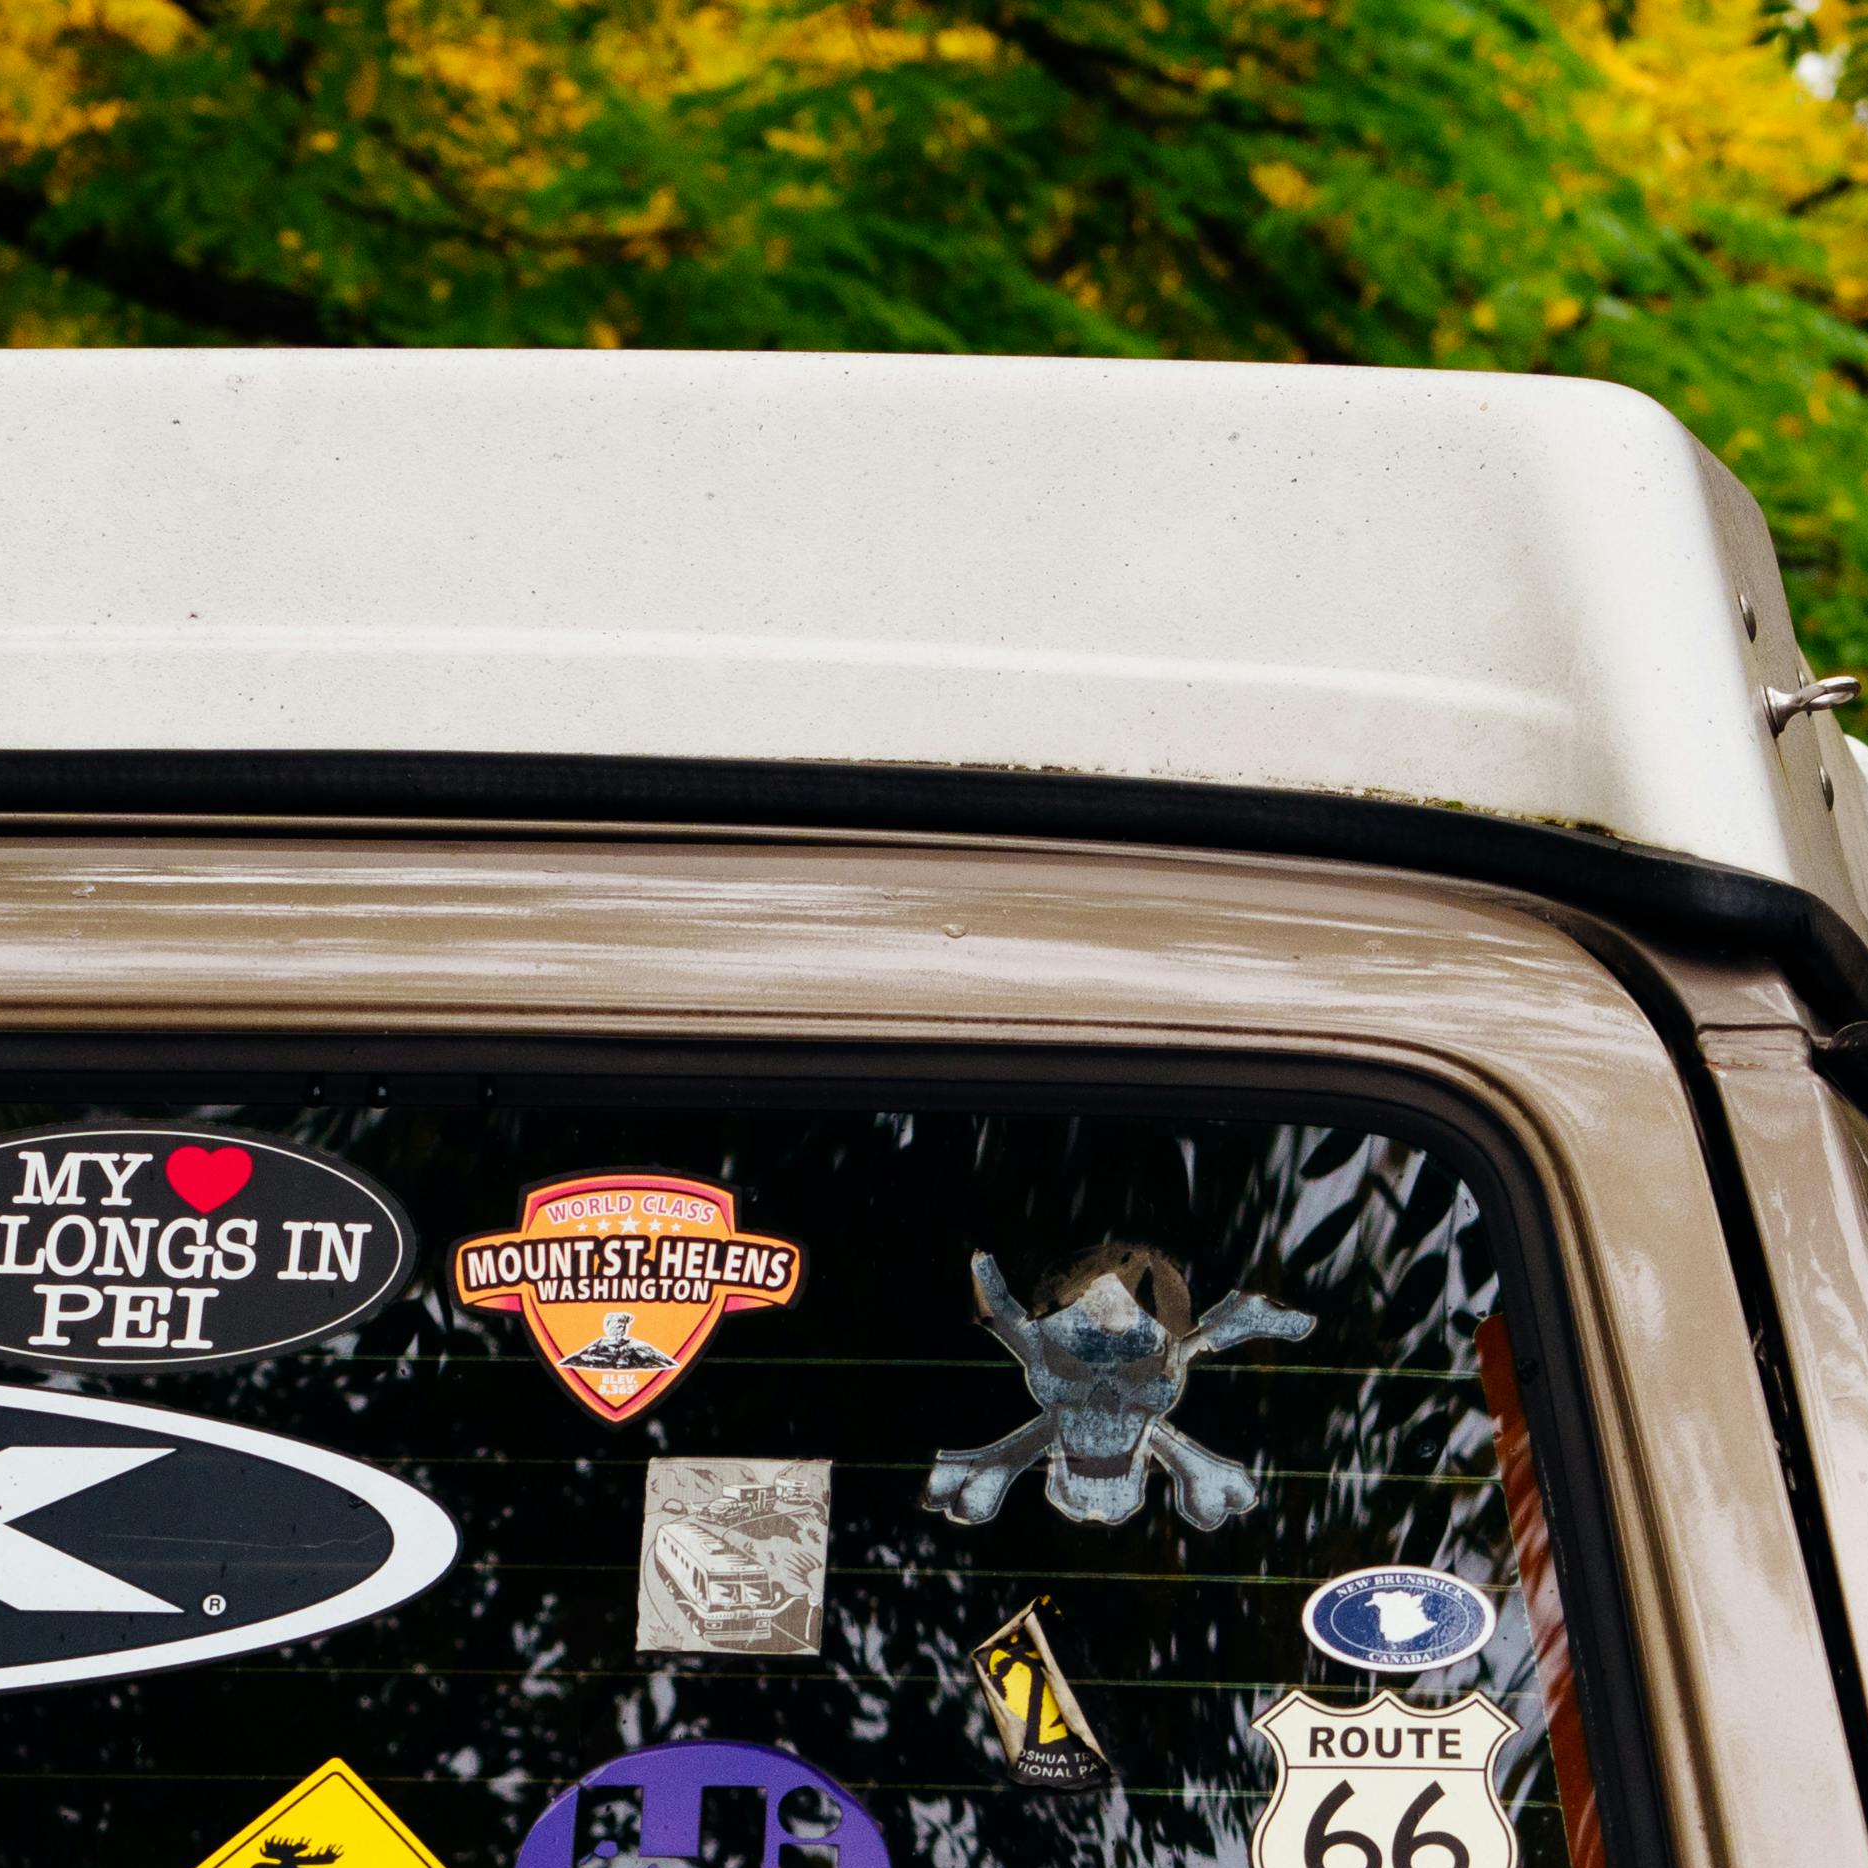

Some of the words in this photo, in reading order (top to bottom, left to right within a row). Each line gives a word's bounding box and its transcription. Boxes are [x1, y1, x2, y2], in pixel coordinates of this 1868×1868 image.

[13, 1151, 153, 1206] MY
[547, 1194, 632, 1224] WORLD
[640, 1194, 716, 1224] CLASS
[276, 1221, 372, 1282] IN
[467, 1240, 596, 1288] MOUNT
[601, 1239, 650, 1277] ST.
[661, 1240, 790, 1288] HELENS
[538, 1278, 710, 1302] WASHINGTON
[28, 1284, 220, 1349] PEI
[1335, 1575, 1372, 1599] NEW
[1374, 1574, 1467, 1601] BRUNSWICK
[1368, 1651, 1432, 1665] CANADA
[1018, 1749, 1068, 1764] OSHUA
[1309, 1726, 1462, 1760] ROUTE
[1018, 1761, 1074, 1778] TIONAL
